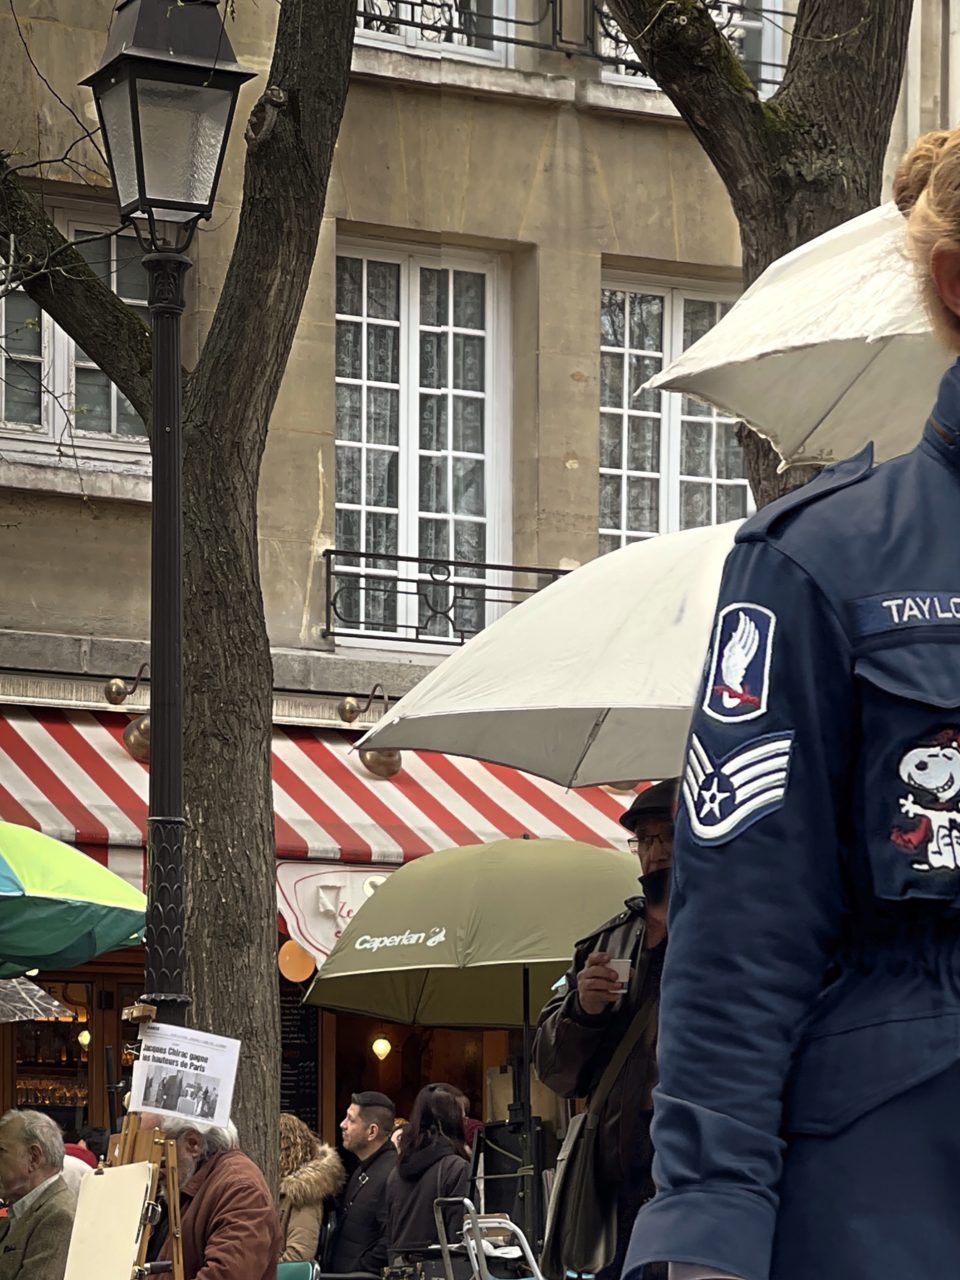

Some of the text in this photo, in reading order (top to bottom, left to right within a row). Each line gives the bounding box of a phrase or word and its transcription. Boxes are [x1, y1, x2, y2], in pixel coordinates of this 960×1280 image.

[355, 930, 426, 952] Caperlan
[143, 1043, 167, 1055] Jacques
[168, 1047, 188, 1059] Chirac
[189, 1052, 209, 1064] gagne
[151, 1054, 179, 1067] hauteurs
[180, 1060, 188, 1069] de
[189, 1061, 206, 1073] Paris
